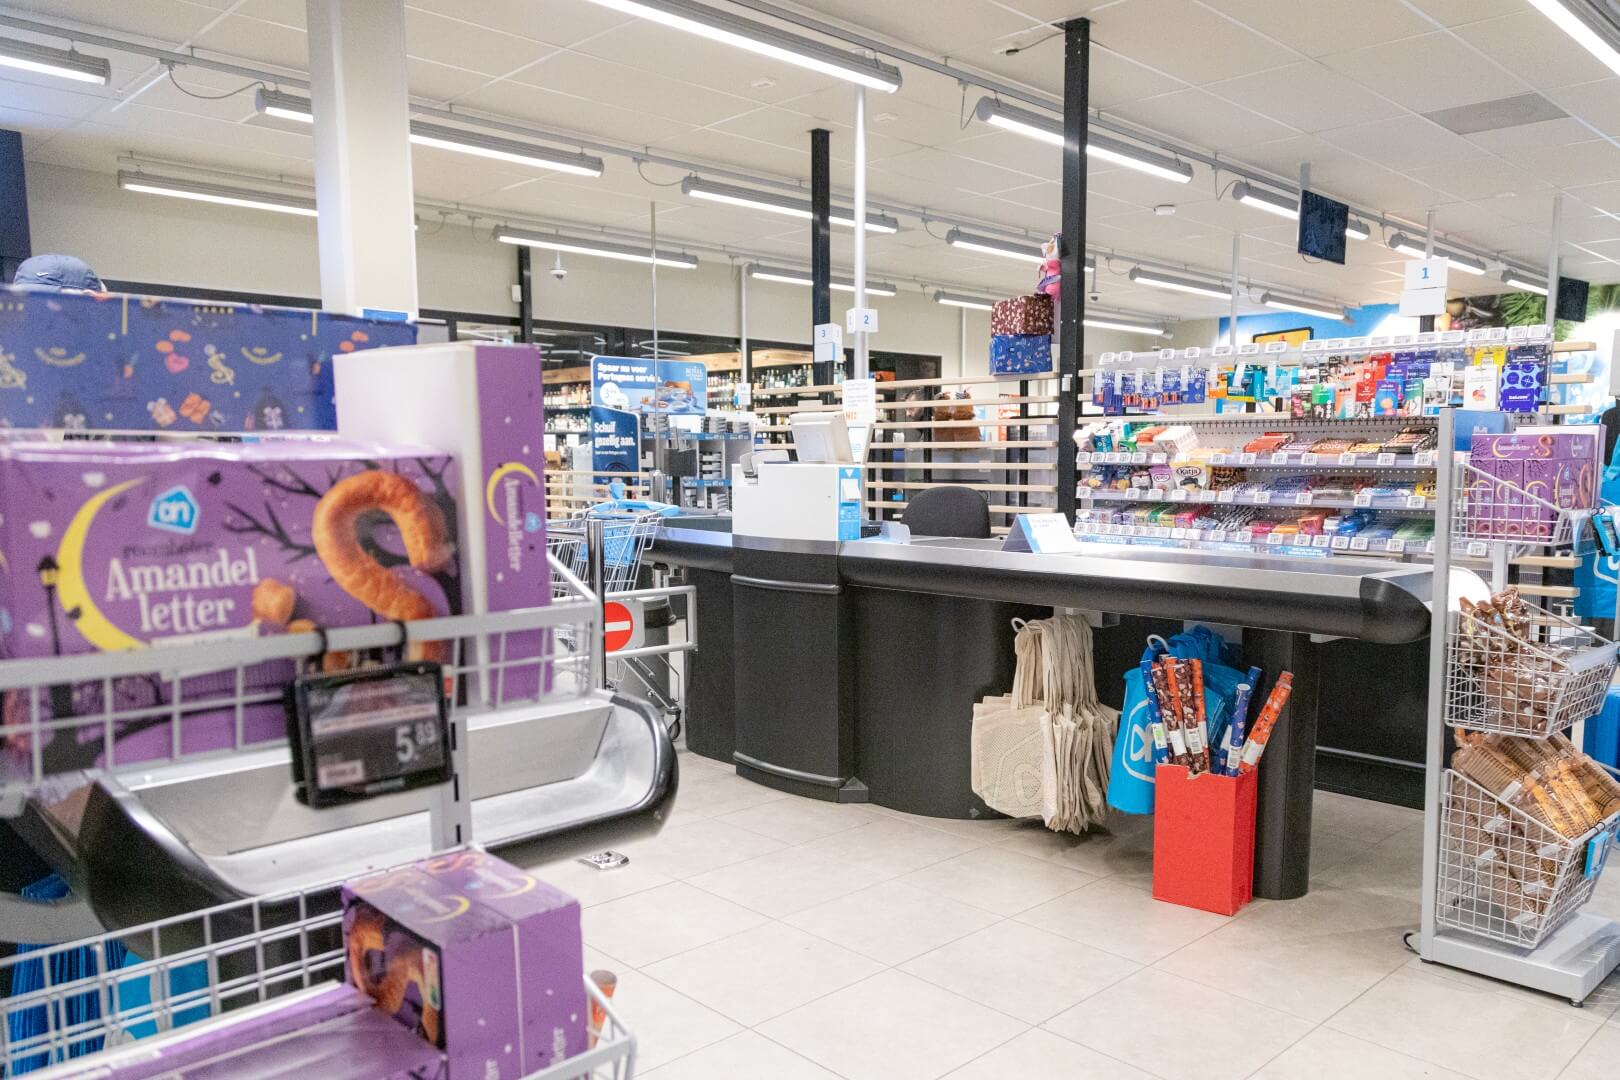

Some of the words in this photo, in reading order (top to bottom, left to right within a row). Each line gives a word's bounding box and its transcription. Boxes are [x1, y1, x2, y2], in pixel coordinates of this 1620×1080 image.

[1421, 266, 1430, 280] 1
[864, 315, 870, 325] 2
[822, 329, 827, 338] 3
[594, 420, 616, 433] Schuif
[1179, 467, 1198, 476] Katja
[105, 546, 260, 601] Amandel
[138, 591, 236, 633] letter
